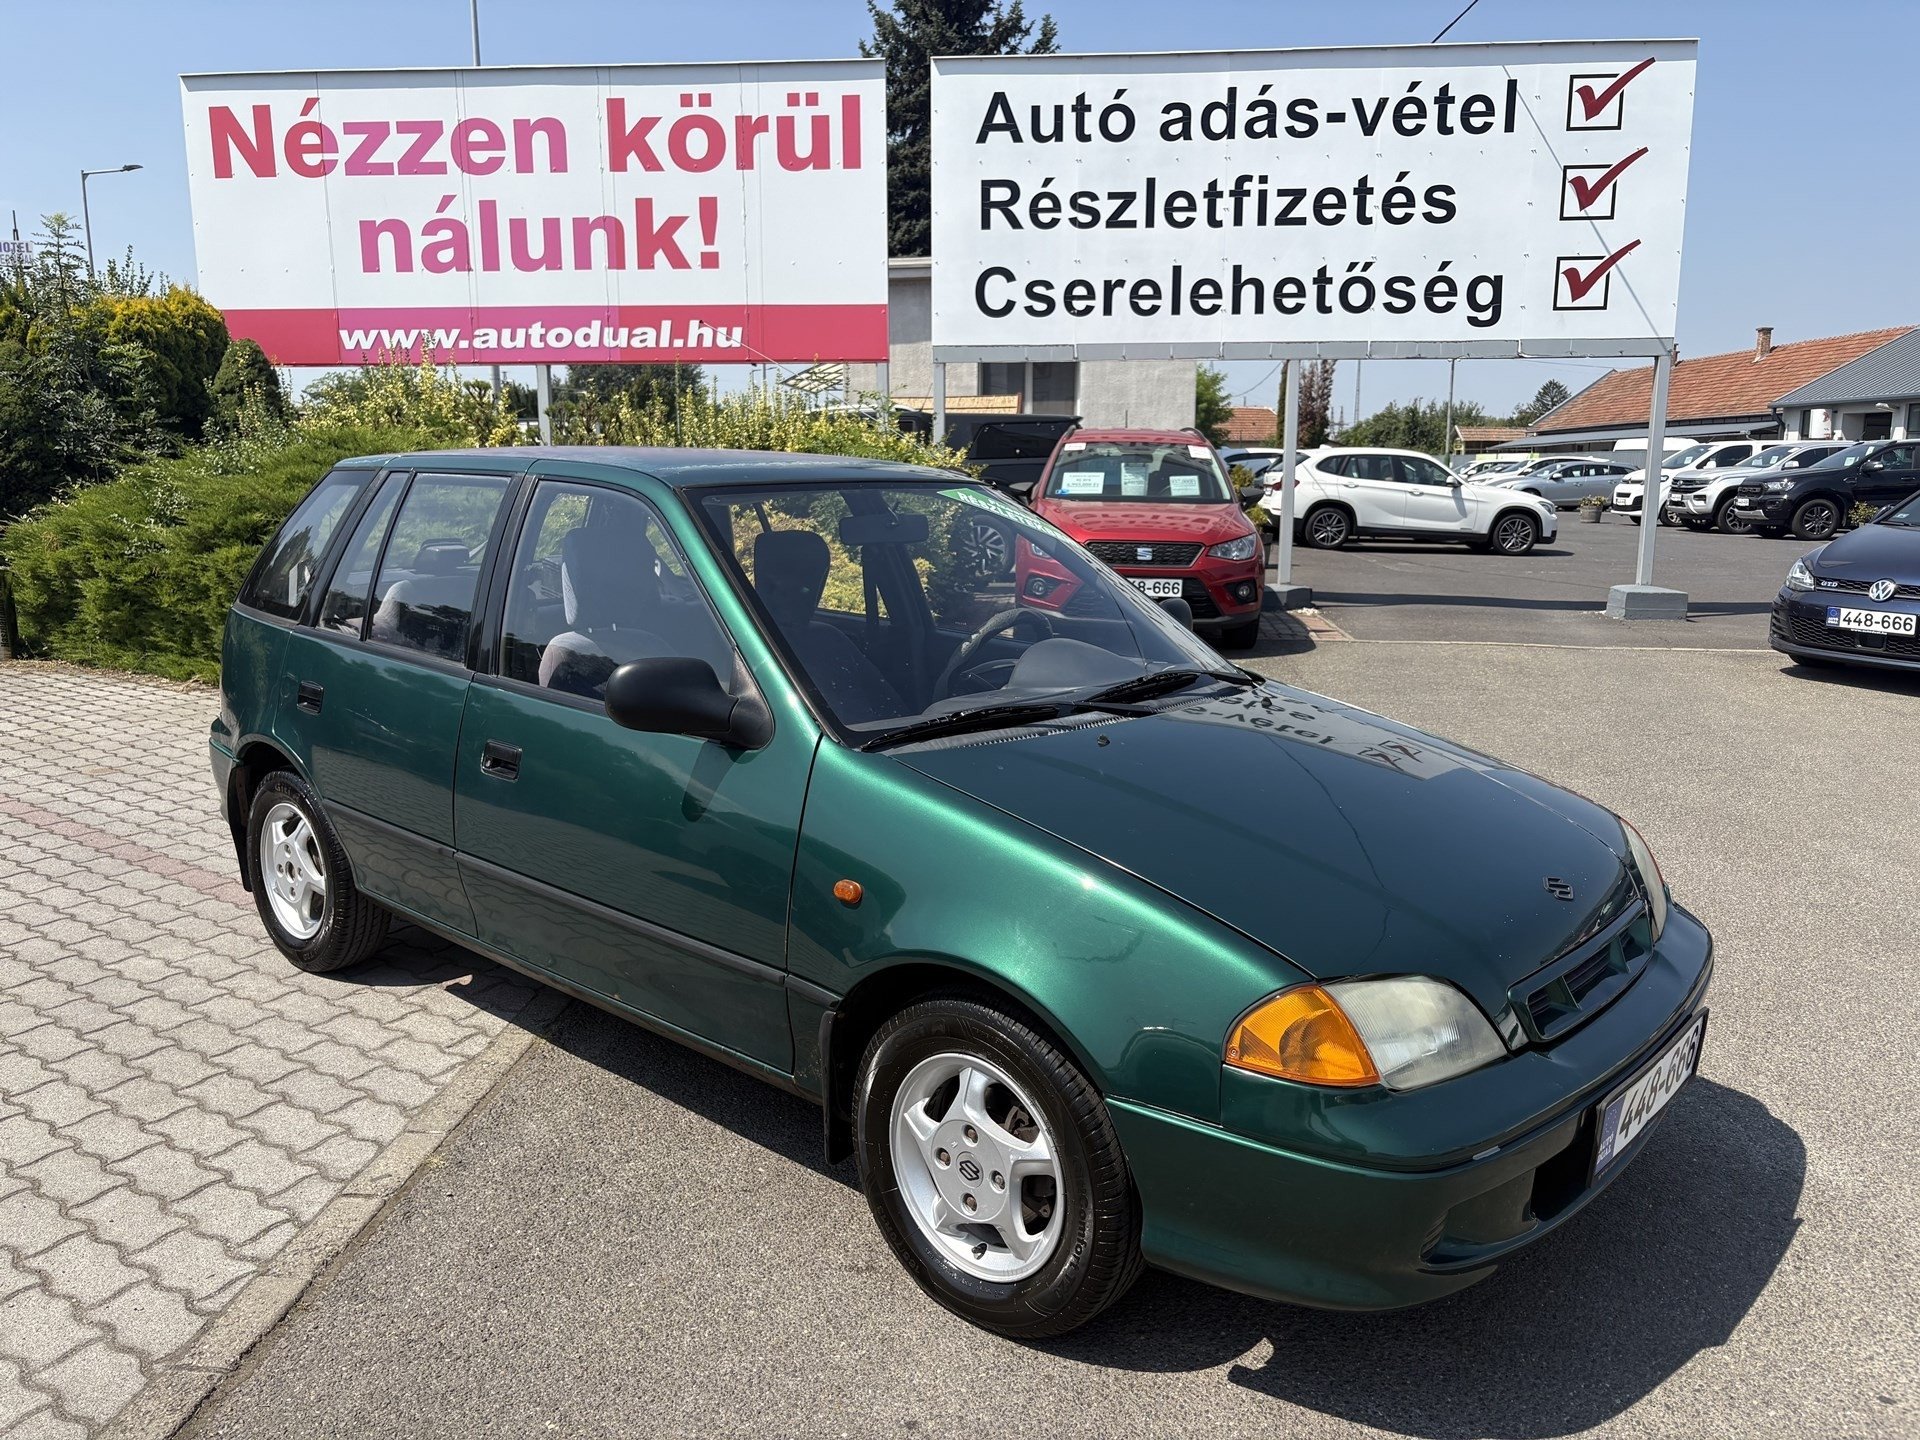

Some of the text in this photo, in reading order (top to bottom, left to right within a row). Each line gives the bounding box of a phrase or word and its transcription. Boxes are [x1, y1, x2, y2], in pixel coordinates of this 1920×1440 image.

[208, 92, 862, 179] Nézzen körül
[976, 79, 1518, 144] Autó adás-vétel
[980, 171, 1457, 231] Részletfizetés
[0, 241, 32, 253] OTEL
[359, 194, 720, 274] nálunk!
[975, 261, 1504, 328] Cserelehetőség
[339, 320, 743, 350] www.autodual.hu
[1131, 580, 1181, 595] 8-666
[1842, 611, 1914, 632] 448-666
[1619, 1025, 1700, 1139] 448-666
